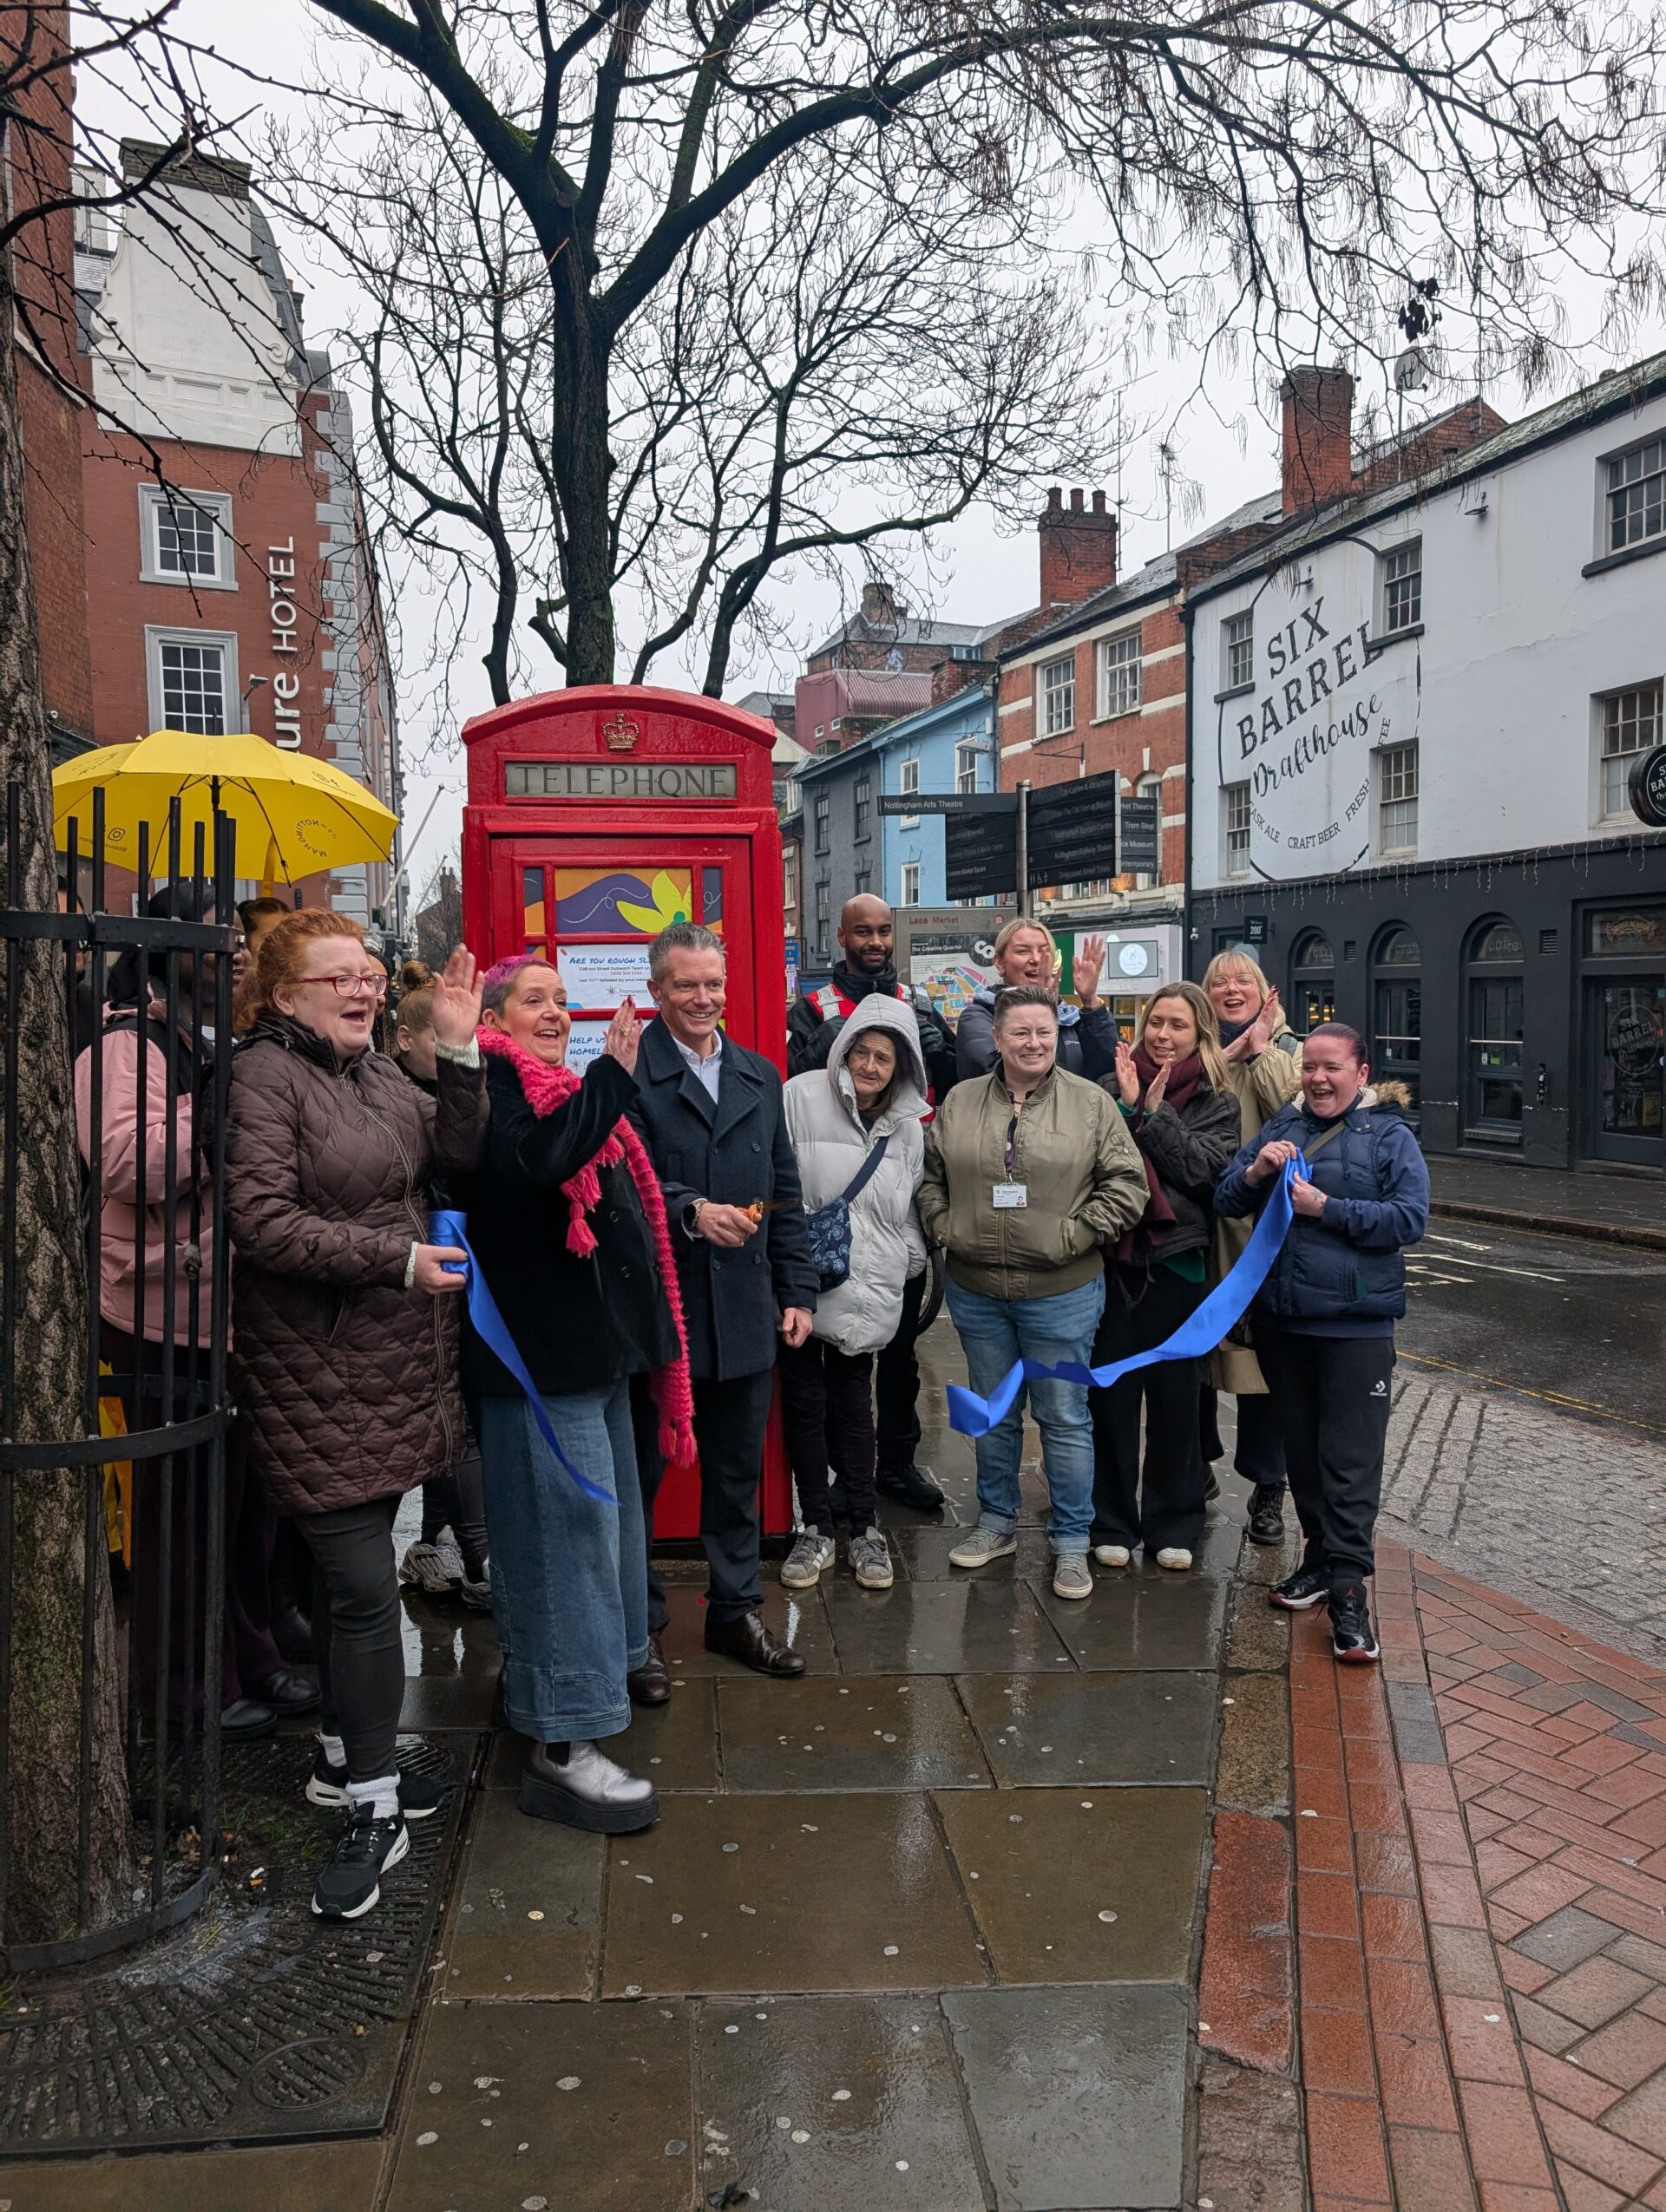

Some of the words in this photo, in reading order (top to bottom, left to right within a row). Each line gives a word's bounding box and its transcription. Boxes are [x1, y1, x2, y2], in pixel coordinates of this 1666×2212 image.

[268, 536, 297, 651] HOTEL
[1267, 596, 1329, 679] SIX
[1236, 620, 1384, 760] BARREL
[1254, 694, 1382, 797] Drafthouse
[515, 767, 729, 797] TELEPHONE
[884, 802, 922, 810] Nottingham
[1141, 822, 1154, 831] Stop
[1264, 825, 1280, 843] ALE
[1288, 835, 1316, 849] CRAFT
[1317, 822, 1341, 845] BEER
[1611, 1021, 1654, 1048] BARREL
